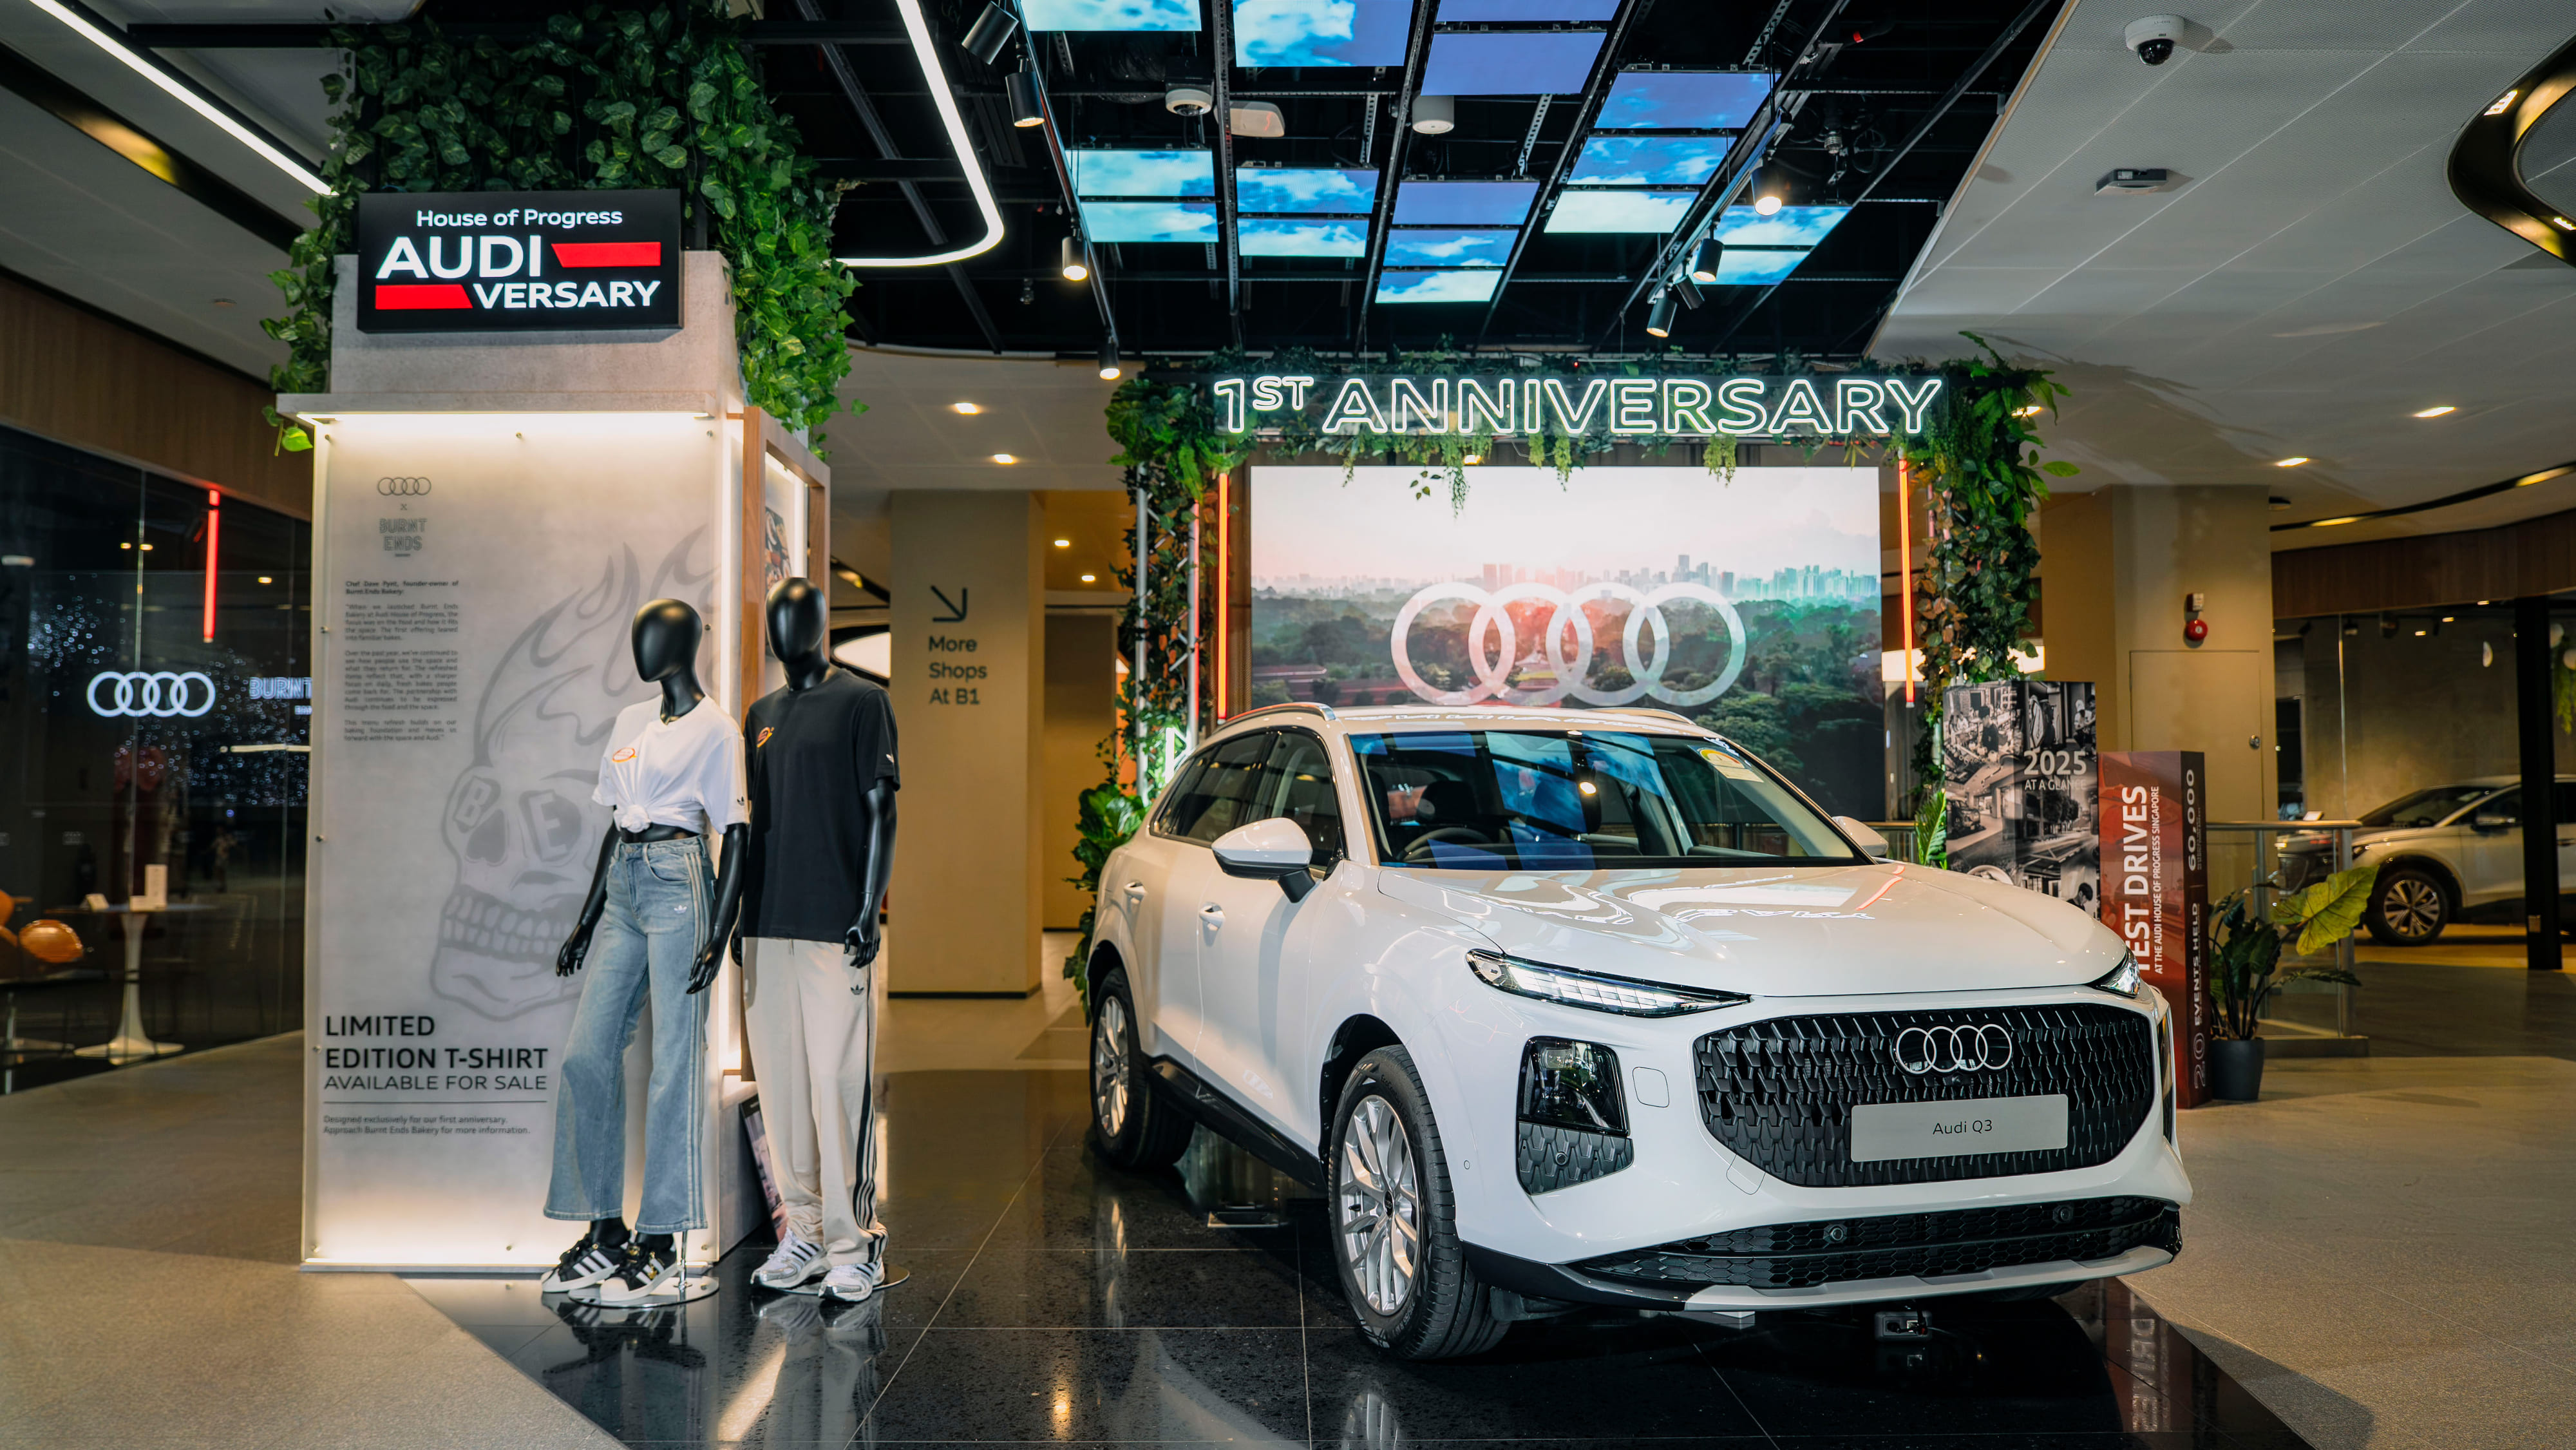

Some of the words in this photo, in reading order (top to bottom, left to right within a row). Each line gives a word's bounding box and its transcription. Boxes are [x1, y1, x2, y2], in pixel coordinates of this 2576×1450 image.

[417, 210, 487, 226] House
[493, 209, 519, 225] of
[524, 209, 622, 229] Progress
[376, 235, 541, 278] AUDI
[473, 281, 660, 309] VERSARY
[1215, 376, 1314, 433] 1ST
[1322, 378, 1942, 434] ANNIVERSARY
[379, 518, 427, 533] BURNT
[384, 536, 422, 551] ENDS
[929, 636, 977, 652] More
[929, 662, 987, 681] Shops
[249, 677, 312, 699] BURNT
[930, 689, 949, 704] At
[956, 688, 979, 705] B1
[2023, 750, 2087, 776] 2025
[2024, 779, 2037, 790] AT
[2038, 779, 2046, 790] A
[2150, 786, 2160, 834] SINGAPORE
[2186, 769, 2197, 871] 60,000
[2122, 786, 2149, 895] DRIVES
[2152, 835, 2161, 879] PROGRESS
[2153, 880, 2161, 892] OF
[2153, 893, 2162, 922] HOUSE
[2154, 924, 2163, 944] AUDI
[2191, 903, 2201, 950] HELD
[2154, 946, 2163, 962] THE
[2154, 963, 2163, 974] AT
[2192, 959, 2201, 1026] EVENTS
[327, 1016, 435, 1036] LIMITED
[327, 1048, 435, 1069] EDITION
[444, 1048, 547, 1069] T-SHIRT
[325, 1076, 438, 1090] AVAILABLE
[446, 1076, 487, 1089] FOR
[495, 1076, 546, 1089] SALE
[324, 1114, 361, 1125] Designed
[410, 1114, 421, 1123] for
[439, 1114, 456, 1123] first
[1933, 1121, 1966, 1134] Audi
[1973, 1120, 1992, 1134] Q3
[324, 1125, 362, 1136] Approach
[365, 1125, 386, 1135] Burnt
[390, 1125, 409, 1135] Ends
[412, 1125, 439, 1136] Bakery
[441, 1125, 452, 1135] for
